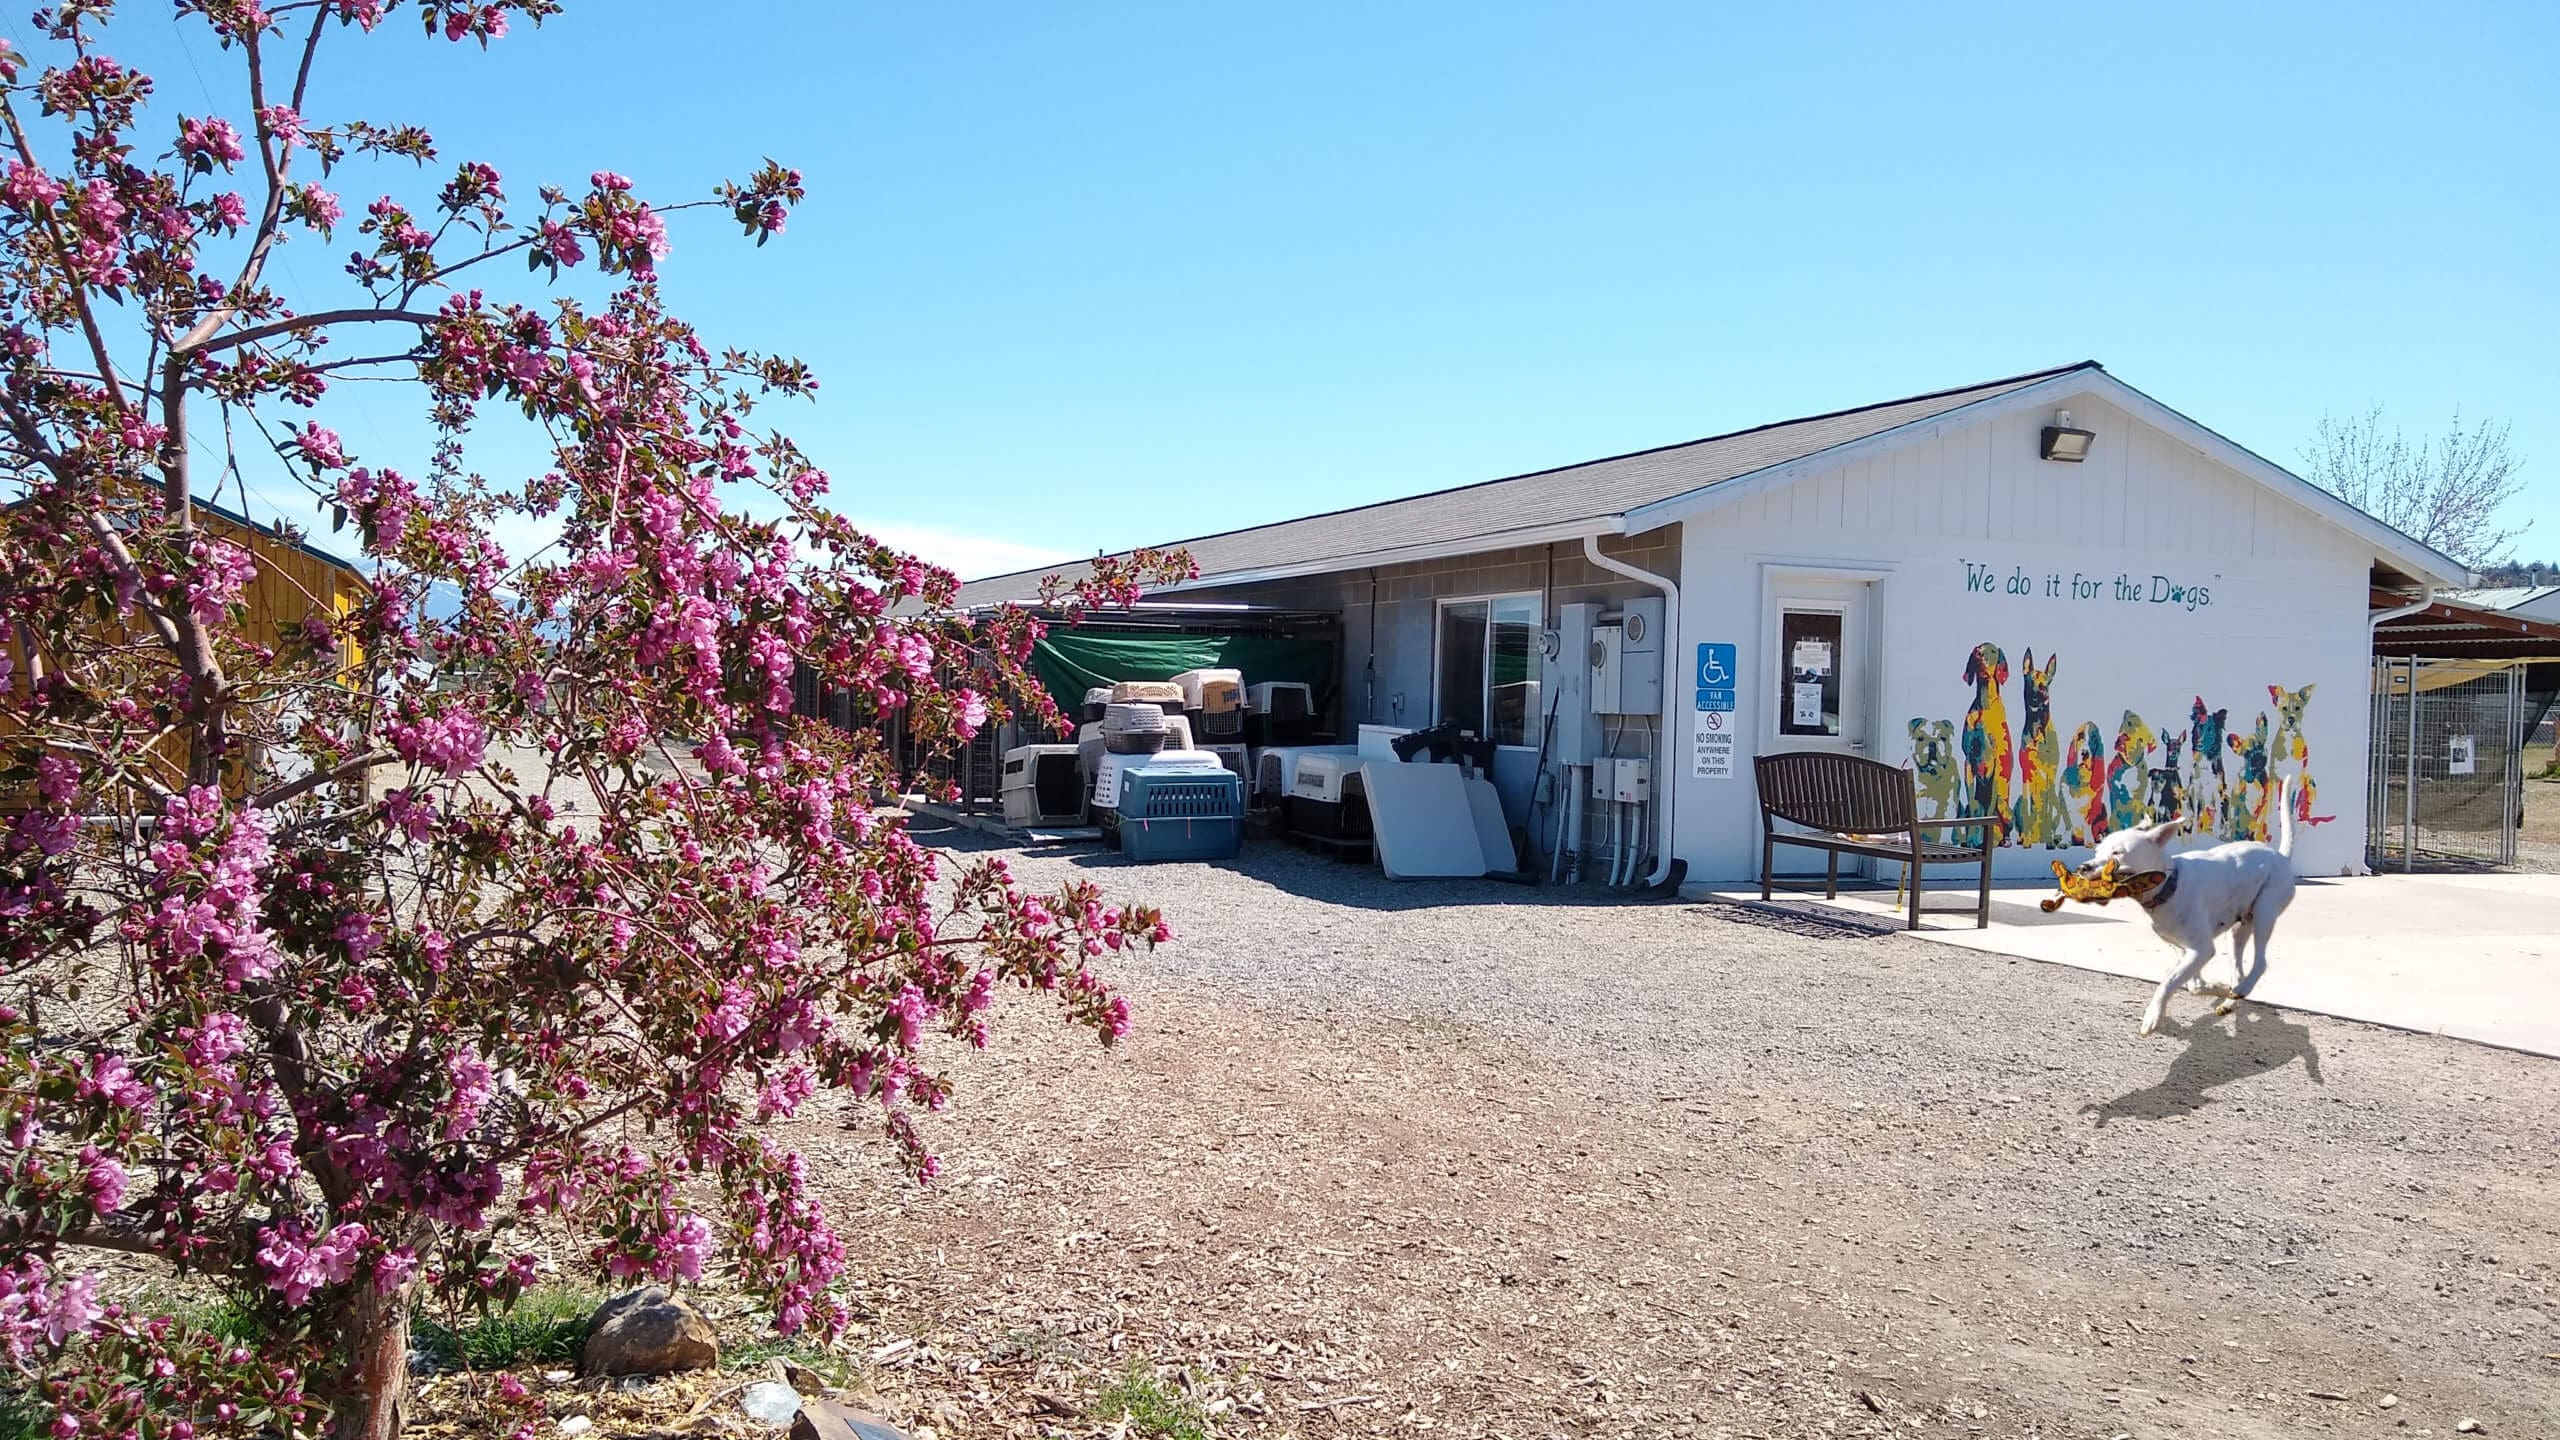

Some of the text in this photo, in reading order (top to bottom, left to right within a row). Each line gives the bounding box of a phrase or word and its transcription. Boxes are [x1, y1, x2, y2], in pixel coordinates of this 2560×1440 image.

[2006, 566, 2032, 596] do
[2045, 573, 2061, 598] it
[2071, 573, 2103, 600] for
[2114, 573, 2142, 602] the
[1709, 691, 1722, 700] VAN
[1697, 701, 1734, 710] ACCESSIBLE
[1696, 732, 1732, 744] NO SMOKING
[1697, 746, 1731, 755] ANYWHERE
[1701, 756, 1725, 765] ON THIS
[1696, 766, 1729, 775] PROPERTY
